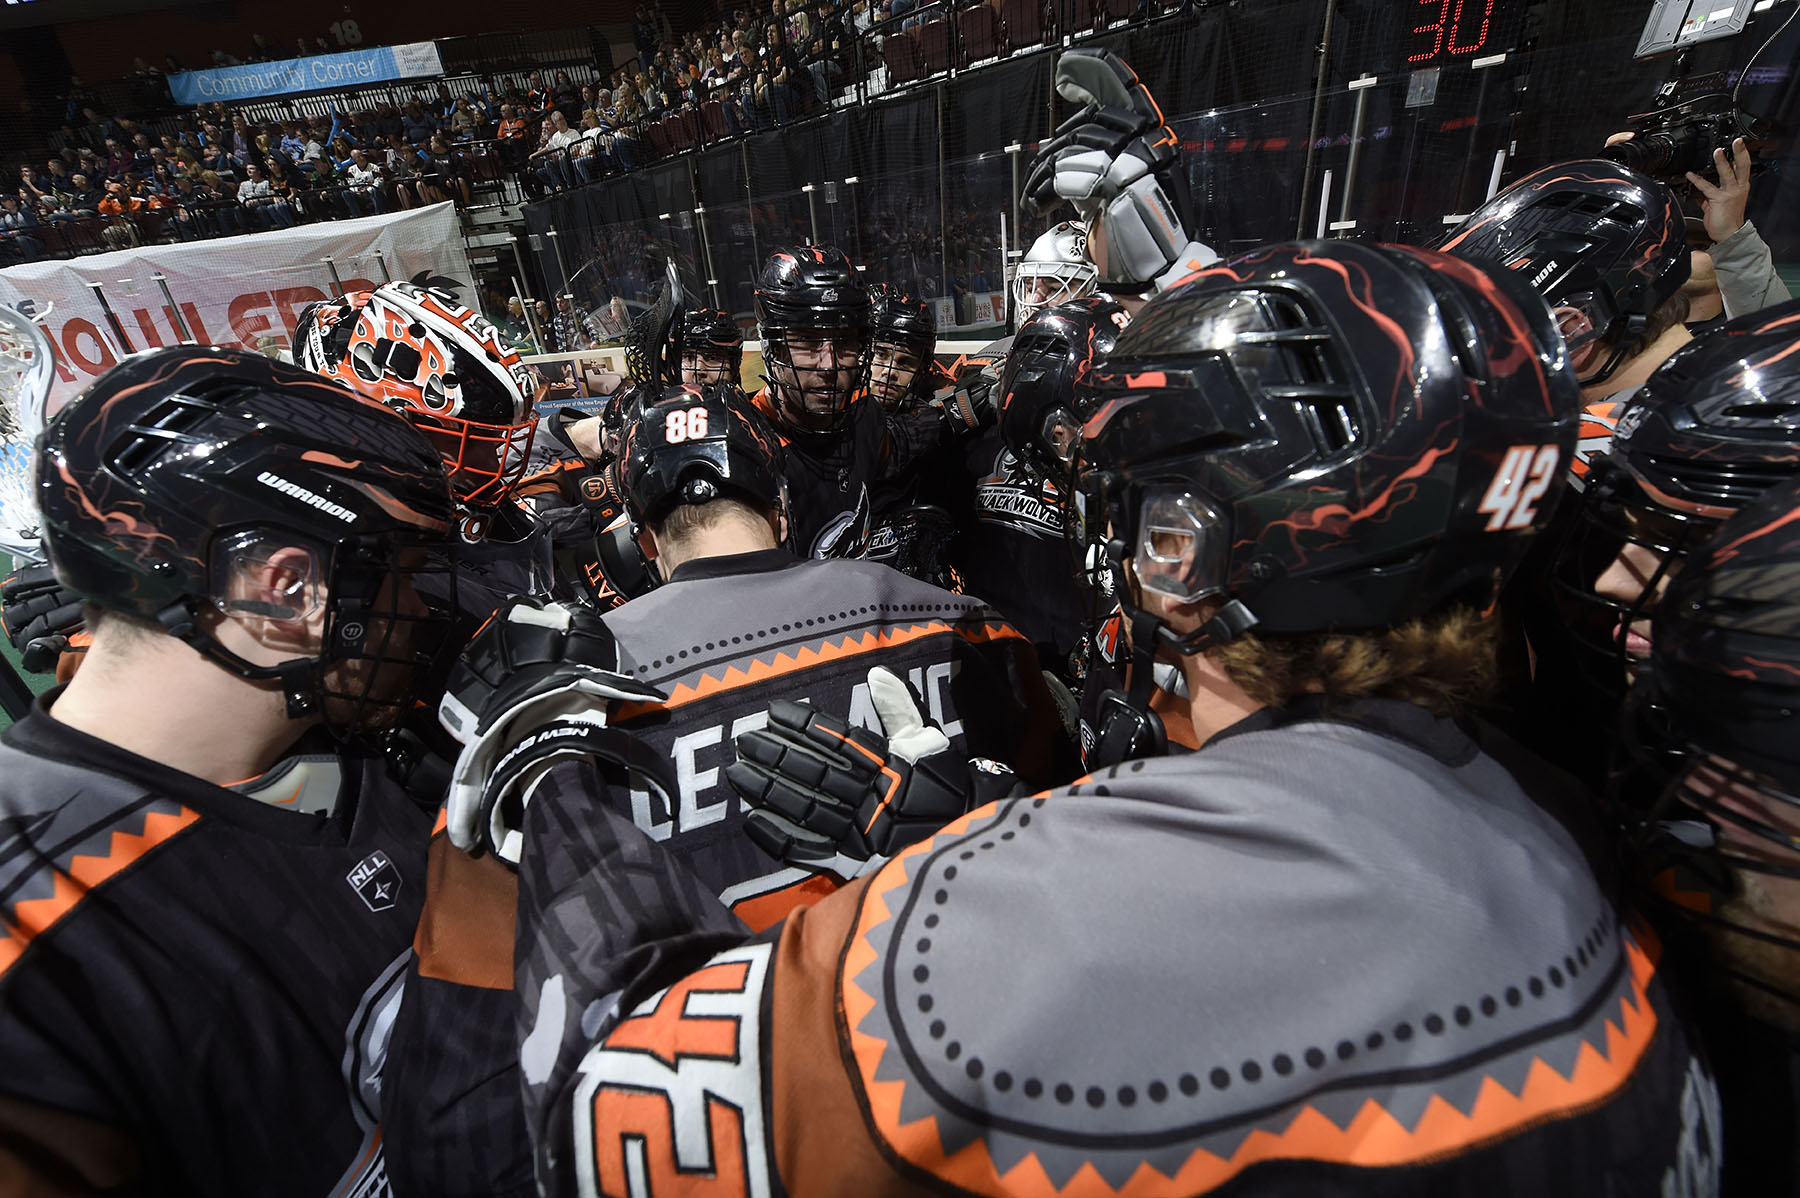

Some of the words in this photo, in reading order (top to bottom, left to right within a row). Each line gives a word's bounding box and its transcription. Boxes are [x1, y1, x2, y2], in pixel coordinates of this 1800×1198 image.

[329, 20, 362, 46] 18
[1408, 0, 1494, 62] 30
[196, 64, 306, 97] Community
[311, 57, 376, 83] Corner
[666, 406, 708, 444] 86
[257, 471, 357, 523] WARRIOR
[1477, 444, 1559, 532] 42
[537, 727, 590, 743] NEW
[351, 857, 387, 887] NLL
